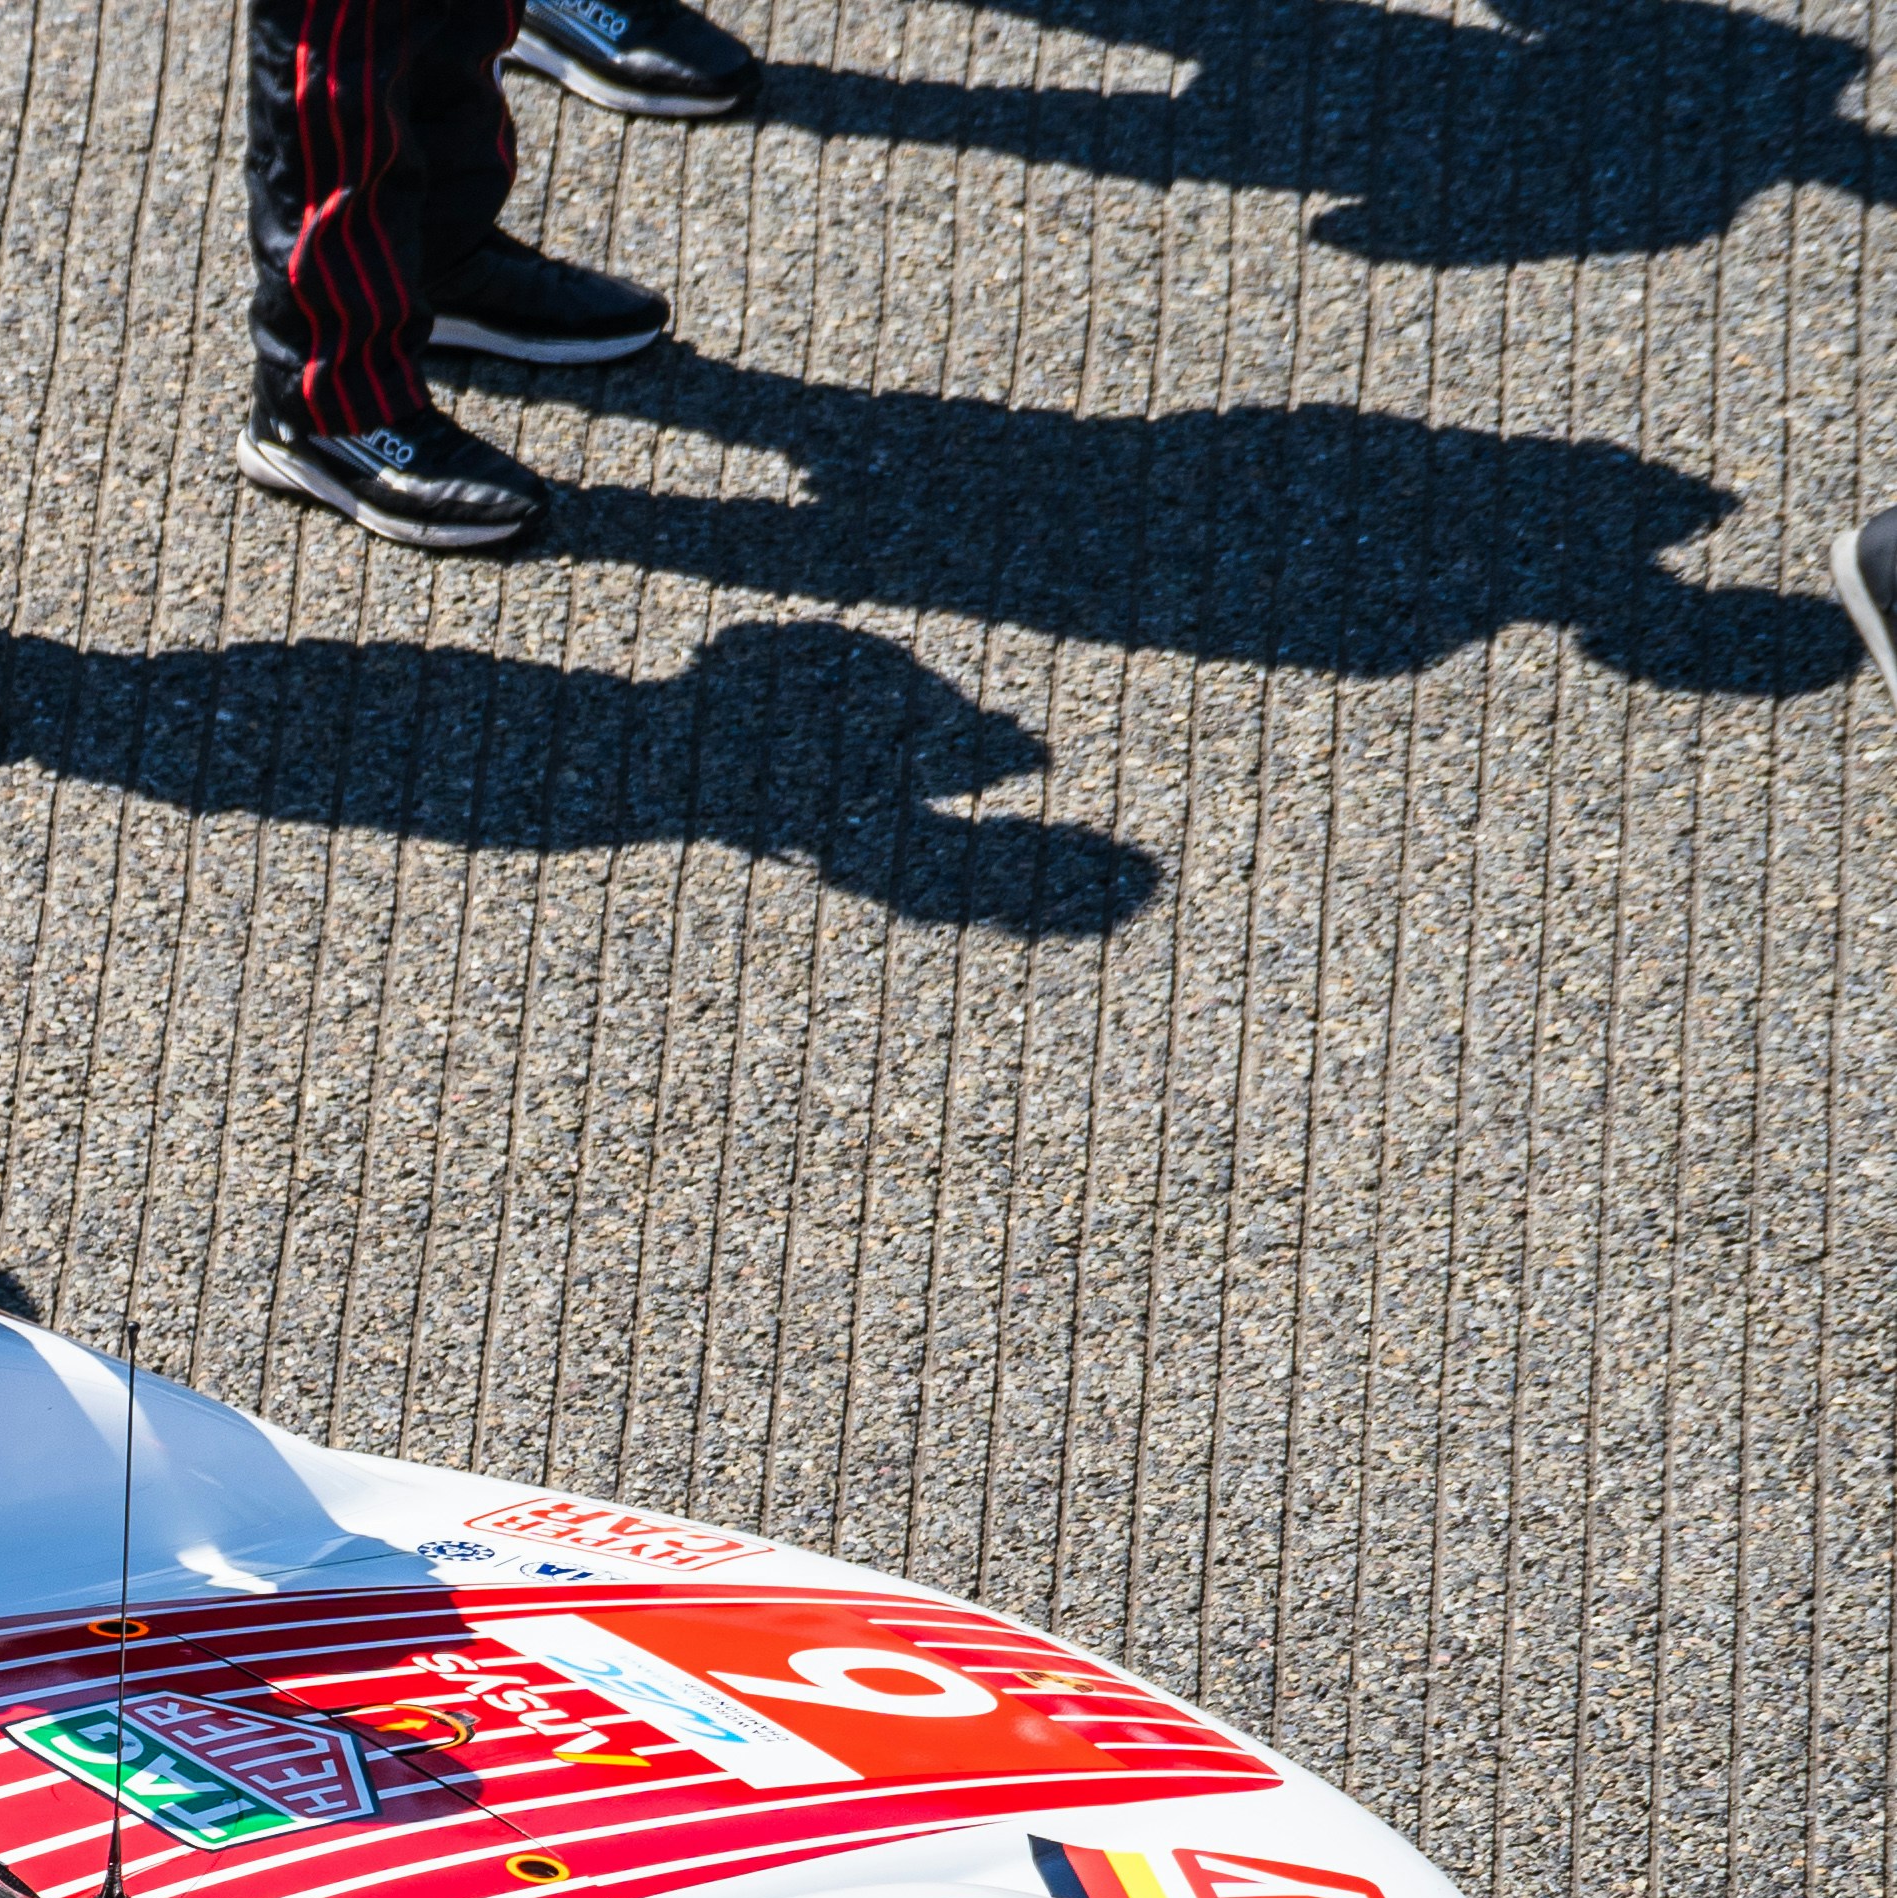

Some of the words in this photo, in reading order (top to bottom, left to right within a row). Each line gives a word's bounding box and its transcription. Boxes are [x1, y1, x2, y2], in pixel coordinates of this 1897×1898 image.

[491, 1515, 706, 1567] HYPER
[527, 1501, 745, 1553] CAR
[412, 1652, 652, 1768] Ansys
[709, 1646, 999, 1719] 6
[45, 1710, 245, 1839] TAG
[131, 1698, 349, 1816] HEUER
